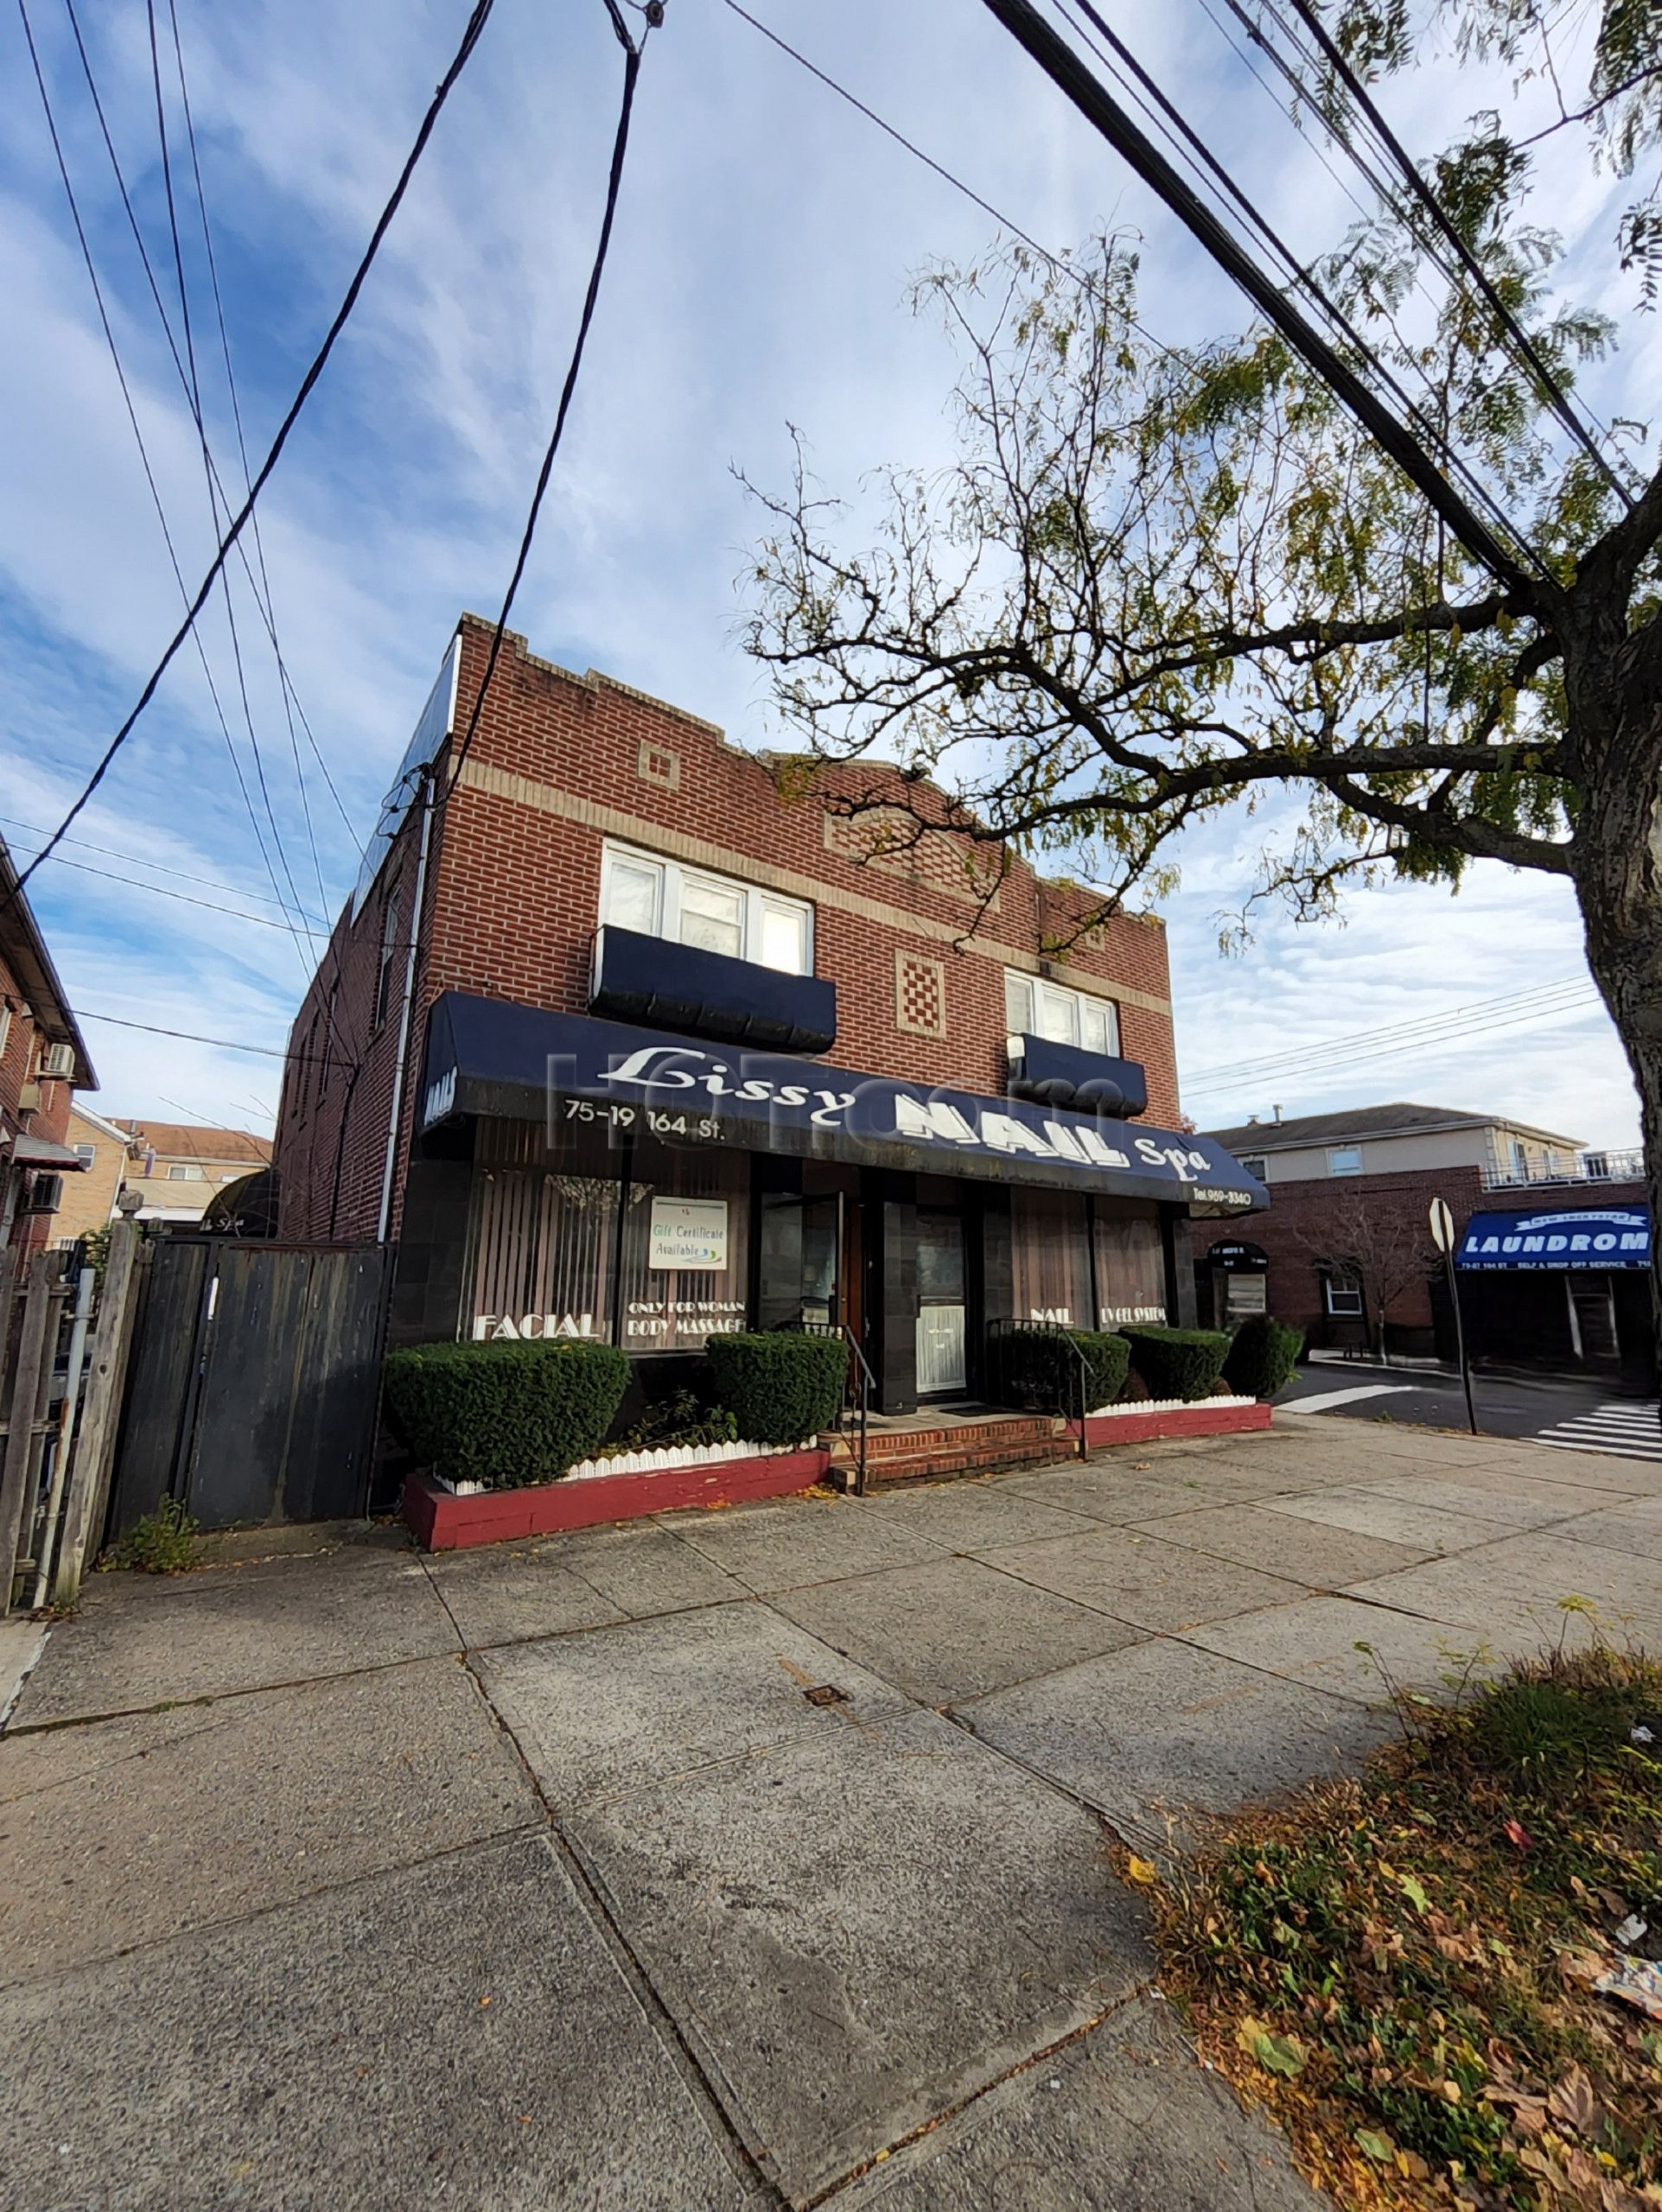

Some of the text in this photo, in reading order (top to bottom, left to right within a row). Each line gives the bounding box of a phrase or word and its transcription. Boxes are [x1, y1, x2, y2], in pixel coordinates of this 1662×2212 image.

[565, 1099, 726, 1141] 75-19 164 St.
[597, 1046, 1212, 1181] Lissy NAIL Spa
[653, 1224, 724, 1239] Gift Certificate
[657, 1243, 698, 1255] Available
[1589, 1261, 1626, 1269] SERVICE
[628, 1301, 746, 1314] ONLY FOR WOMAN
[1031, 1307, 1074, 1325] NAIL
[473, 1313, 601, 1340] FACIAL
[627, 1319, 670, 1336] BODY
